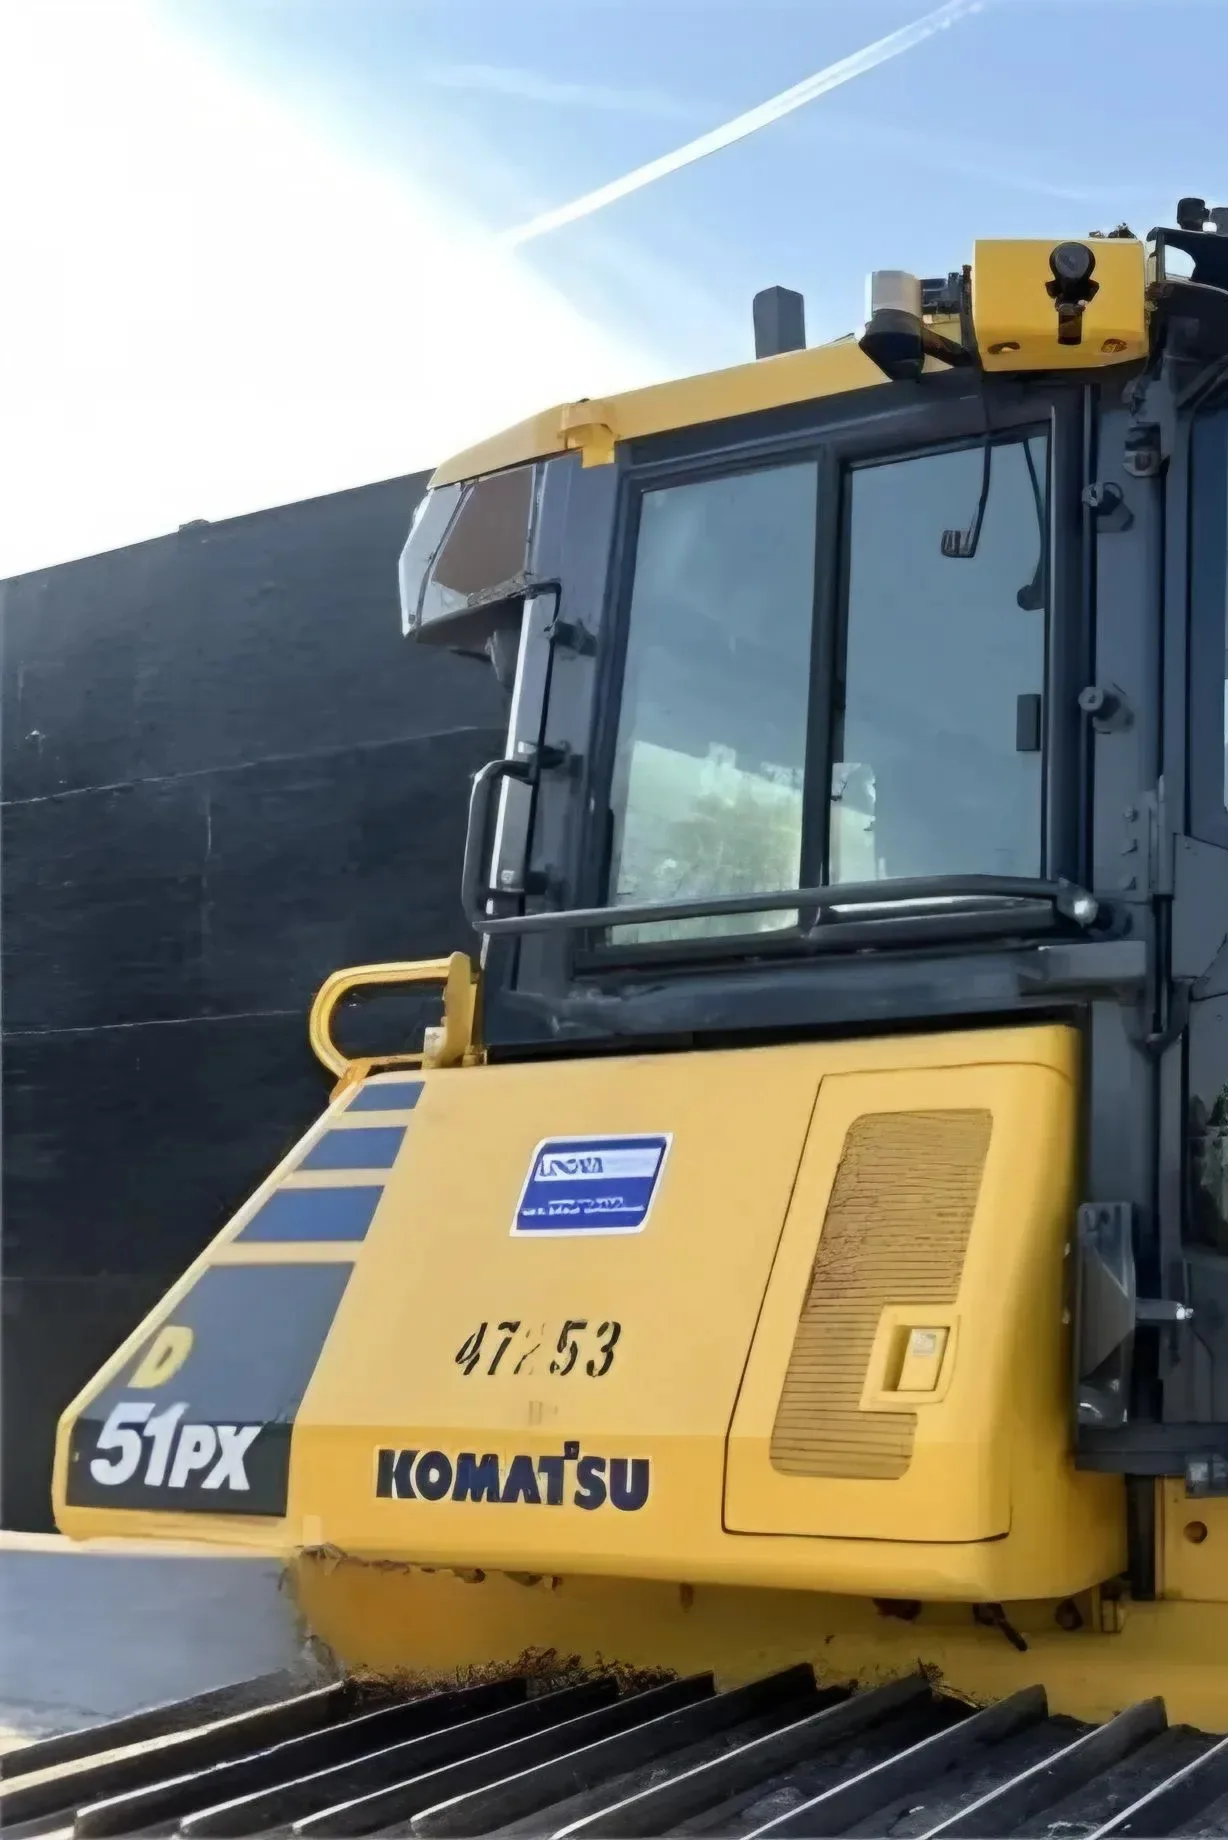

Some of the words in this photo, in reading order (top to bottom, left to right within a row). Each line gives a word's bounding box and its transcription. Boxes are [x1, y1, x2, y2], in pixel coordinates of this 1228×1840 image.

[127, 1325, 194, 1388] D
[455, 1320, 622, 1377] 4753
[90, 1402, 262, 1490] 51PX
[376, 1440, 650, 1511] KOMATSU
